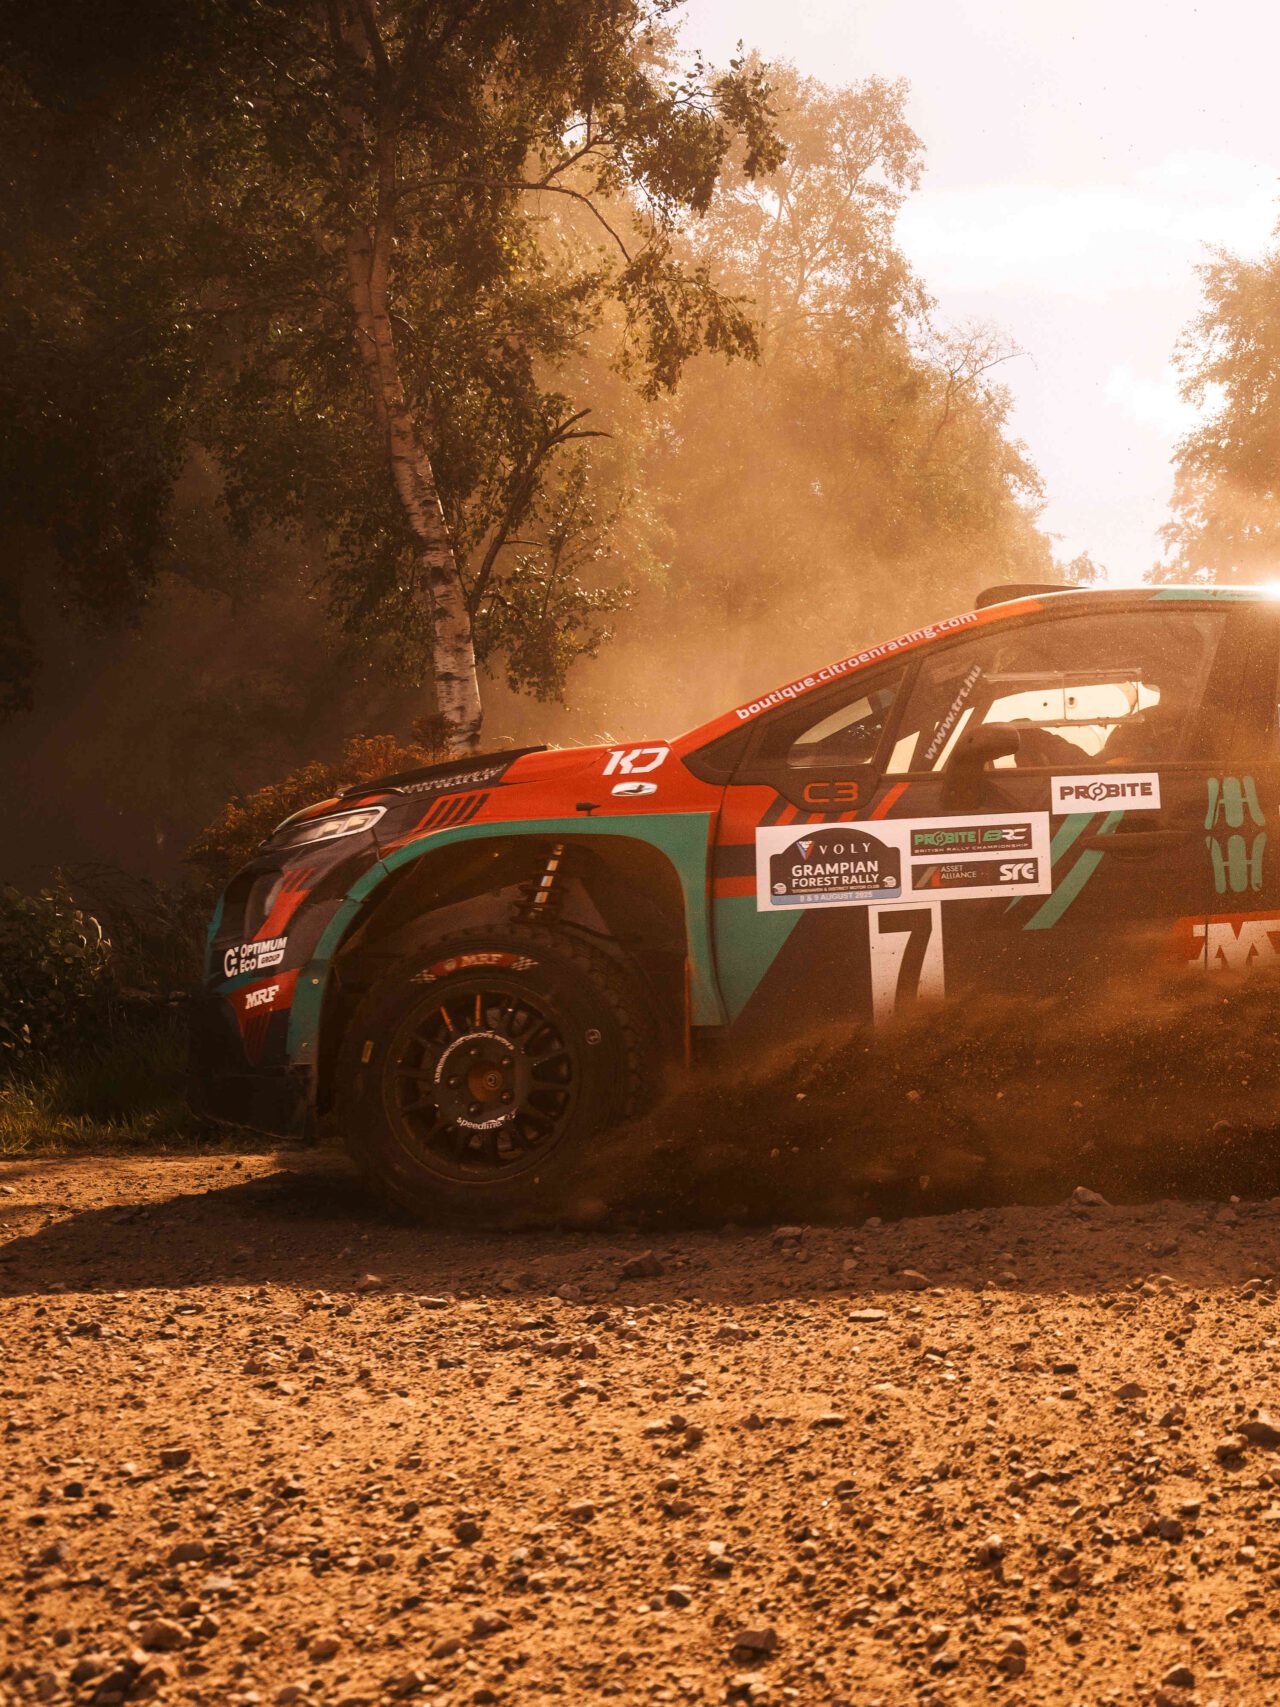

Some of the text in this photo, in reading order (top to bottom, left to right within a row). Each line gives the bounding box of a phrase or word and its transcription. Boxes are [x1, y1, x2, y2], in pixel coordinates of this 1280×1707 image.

[736, 612, 978, 720] boutique.citroenracing.com
[924, 664, 982, 760] www.trt.hu
[803, 781, 858, 803] C3
[1059, 781, 1153, 801] PROBITE
[914, 829, 977, 846] PROBITE
[819, 842, 871, 855] VOLY
[791, 860, 880, 877] GRAMPIAN
[941, 864, 963, 872] ASSET
[941, 871, 977, 880] ALLIANCE
[792, 874, 880, 888] FOREST RALLY
[820, 892, 853, 901] AUGUST
[241, 936, 288, 958] OPTIMUM
[240, 953, 281, 974] ECO GROUP
[460, 953, 503, 967] MRF
[877, 908, 933, 1018] 7
[245, 985, 280, 1010] MRF
